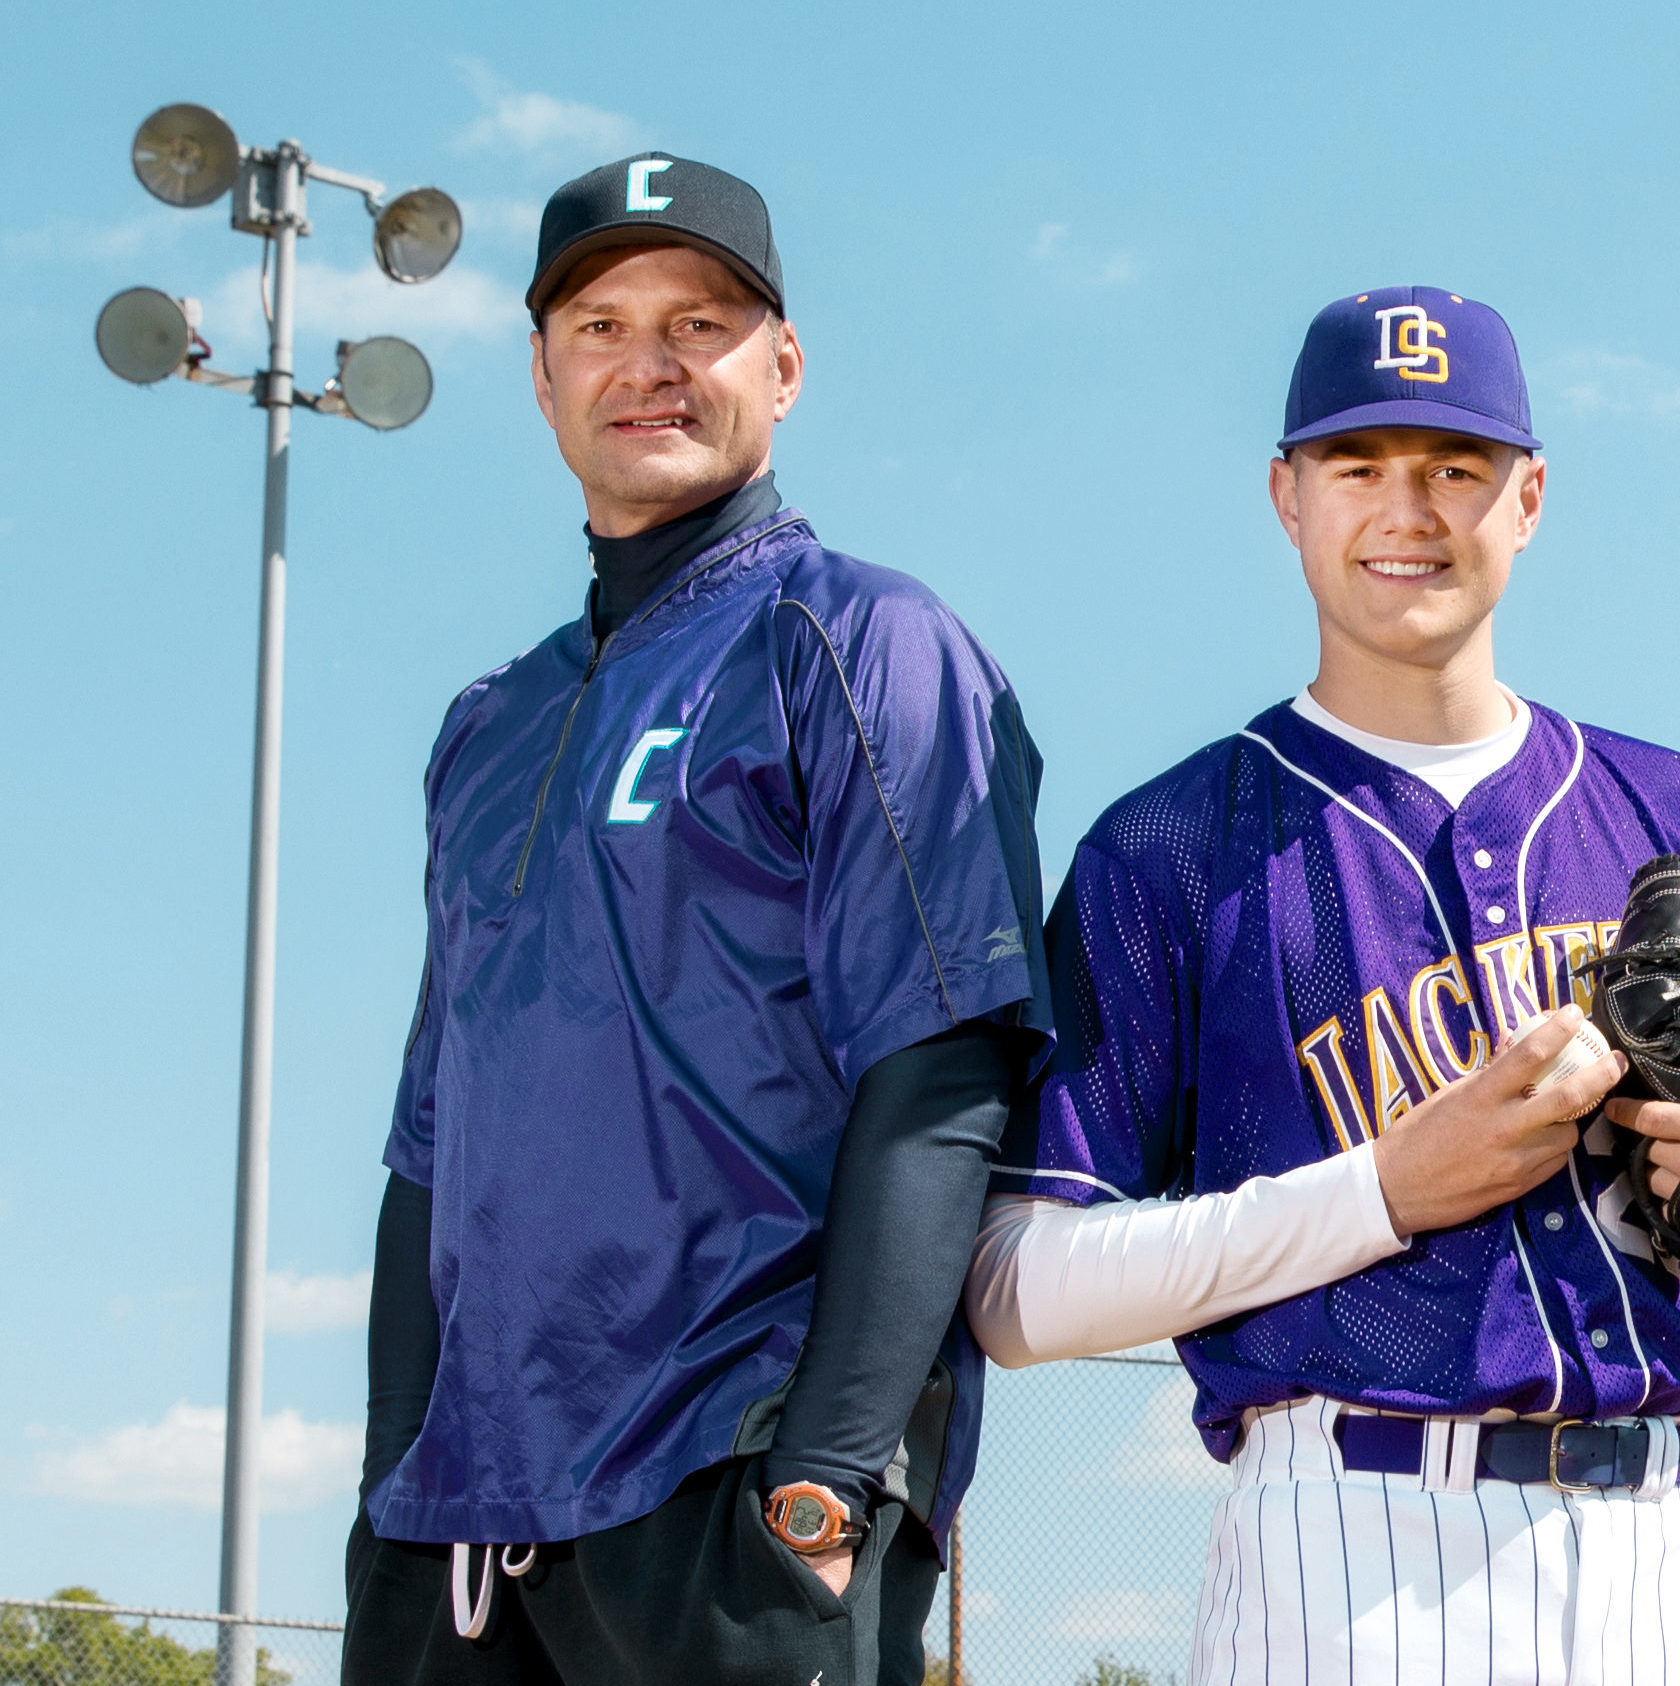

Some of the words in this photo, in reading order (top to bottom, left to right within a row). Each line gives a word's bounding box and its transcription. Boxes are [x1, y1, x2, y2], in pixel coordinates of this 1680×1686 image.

[626, 159, 674, 212] C
[1374, 305, 1449, 383] DS
[607, 727, 690, 824] C
[1298, 921, 1621, 1151] JACKE
